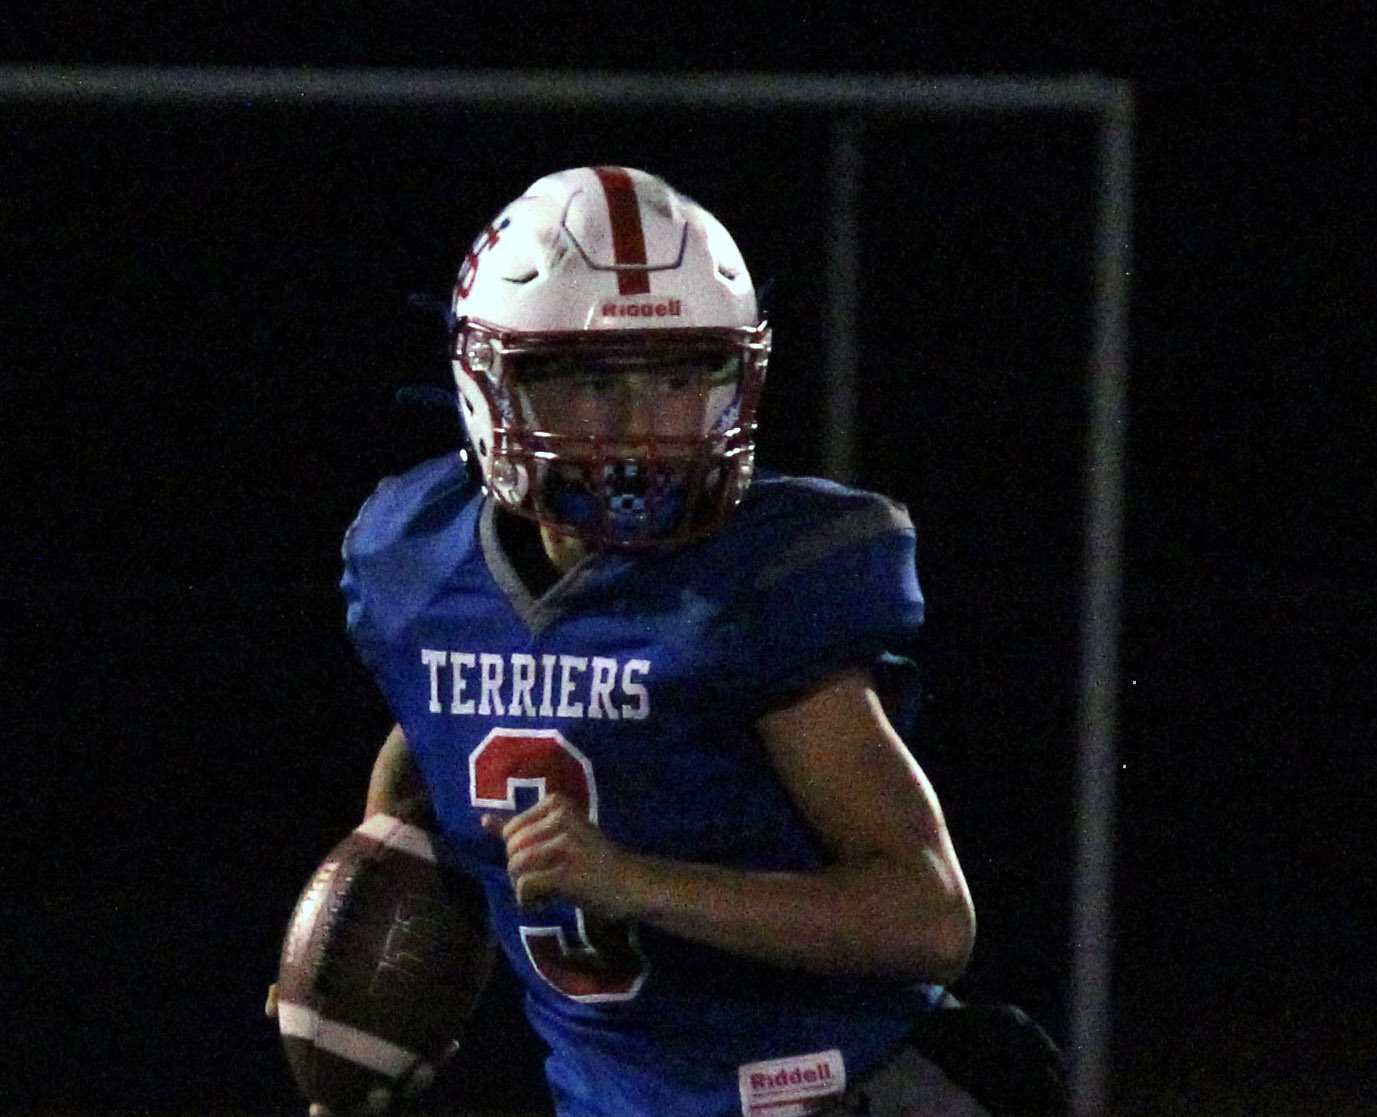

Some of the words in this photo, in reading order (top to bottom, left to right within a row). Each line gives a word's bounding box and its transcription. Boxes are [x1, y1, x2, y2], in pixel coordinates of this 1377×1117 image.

[421, 648, 652, 721] TERRIERS
[468, 726, 653, 1004] 3
[750, 1062, 831, 1090] Riddell
